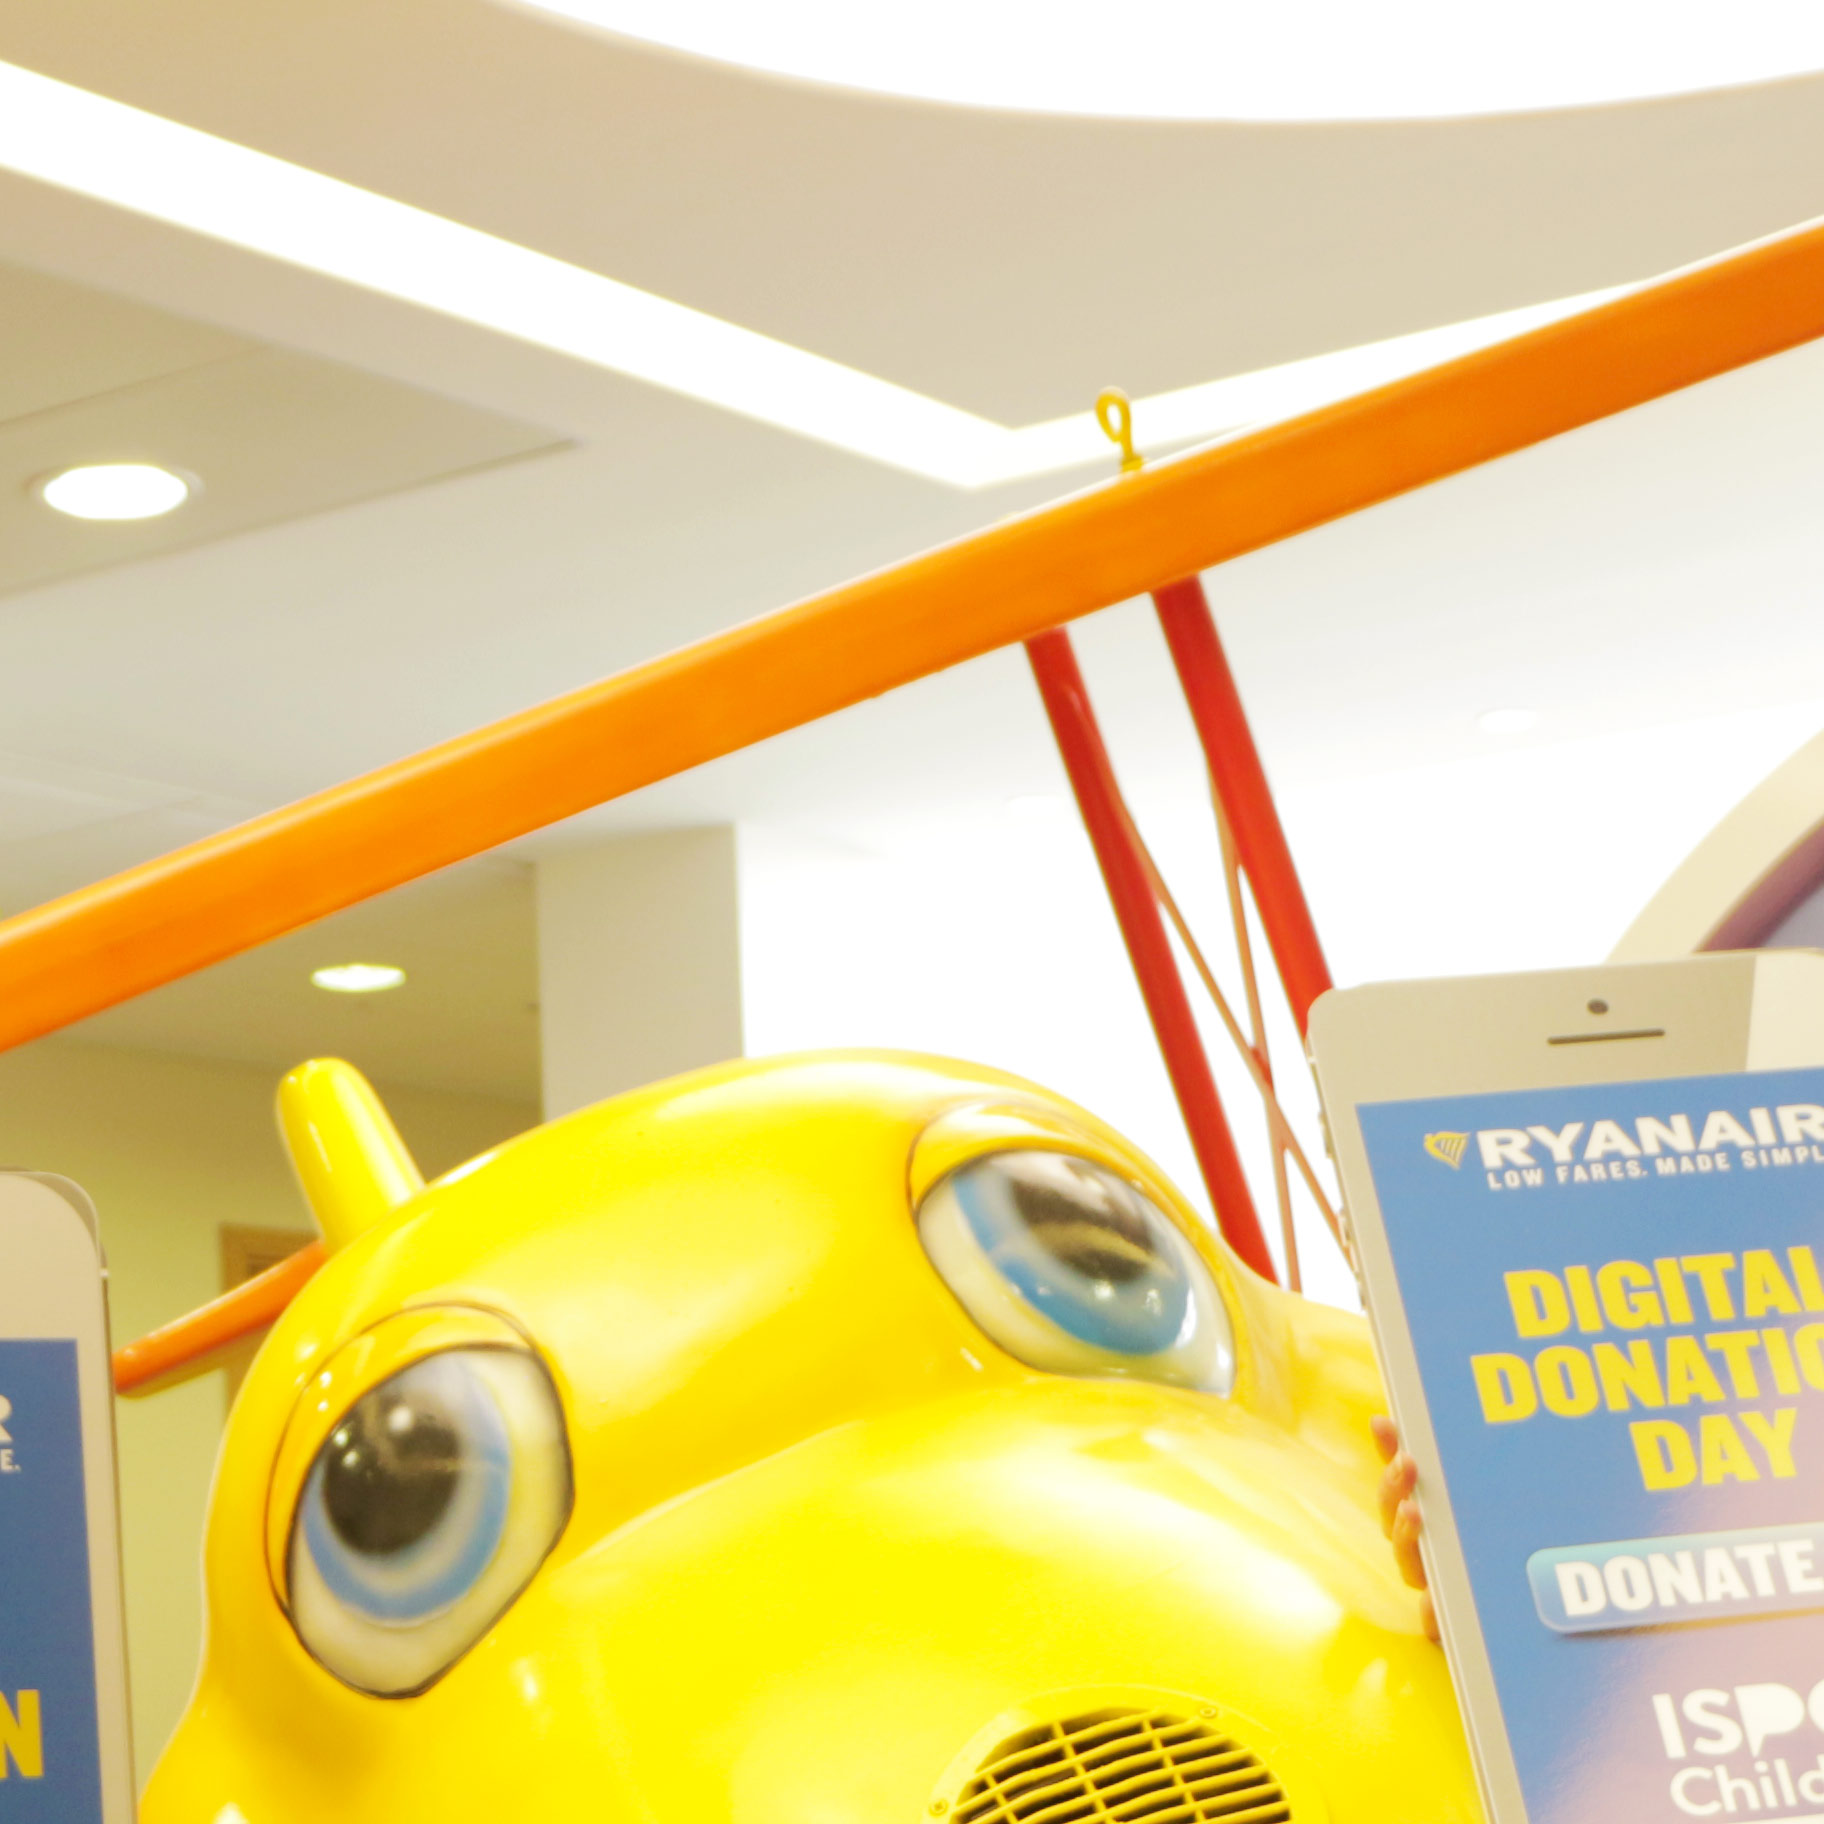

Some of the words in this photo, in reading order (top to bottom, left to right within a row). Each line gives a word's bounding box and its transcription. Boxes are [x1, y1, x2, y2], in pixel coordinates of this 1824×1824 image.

[1487, 1167, 1544, 1190] LOW
[1556, 1161, 1648, 1185] FARES.
[1656, 1152, 1731, 1176] MADE
[1629, 1407, 1798, 1492] DAY
